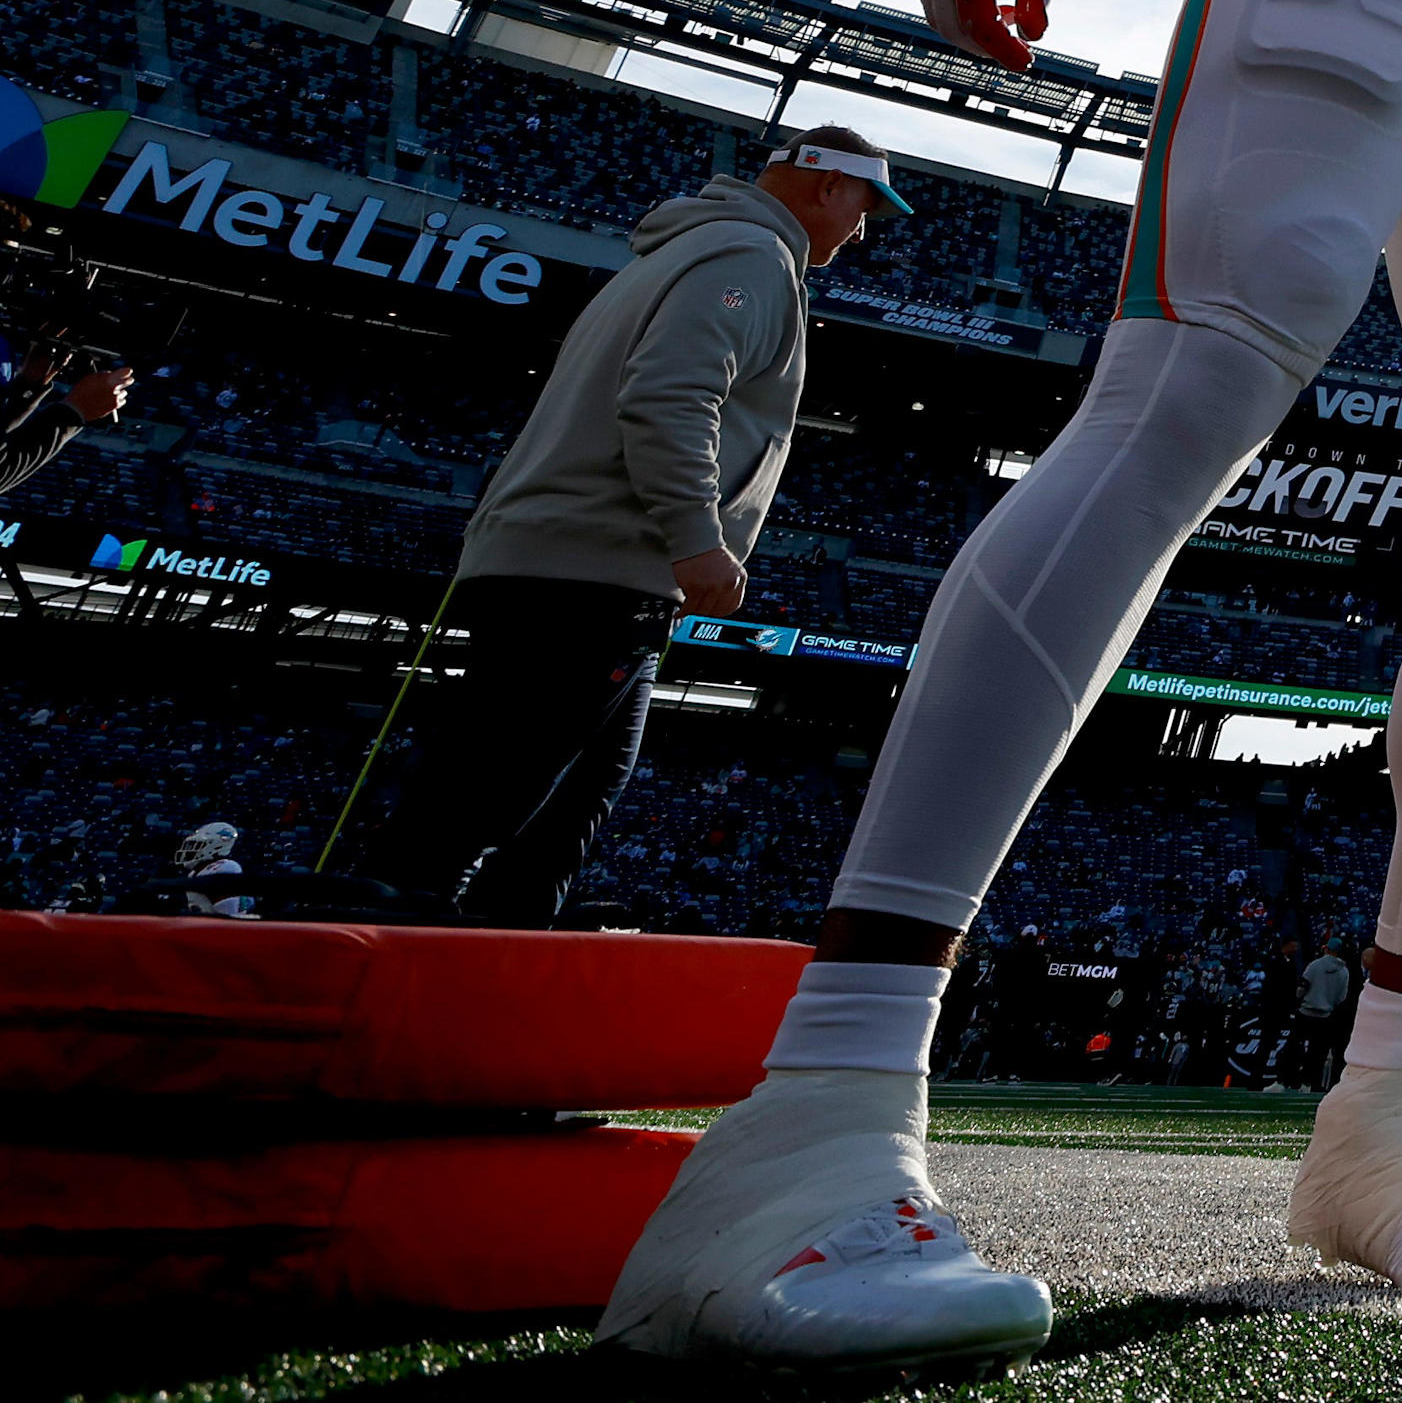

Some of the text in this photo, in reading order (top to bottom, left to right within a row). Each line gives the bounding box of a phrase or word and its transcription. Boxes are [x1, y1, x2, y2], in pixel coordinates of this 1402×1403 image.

[101, 140, 543, 306] MetLife
[825, 288, 995, 330] SUPER BOWL III
[882, 312, 1013, 345] CHAMPIONS
[145, 547, 272, 586] MetLife
[1187, 536, 1344, 566] GAMETMEWATCH.COM
[692, 623, 723, 641] MIA
[1047, 962, 1119, 980] BETMGM
